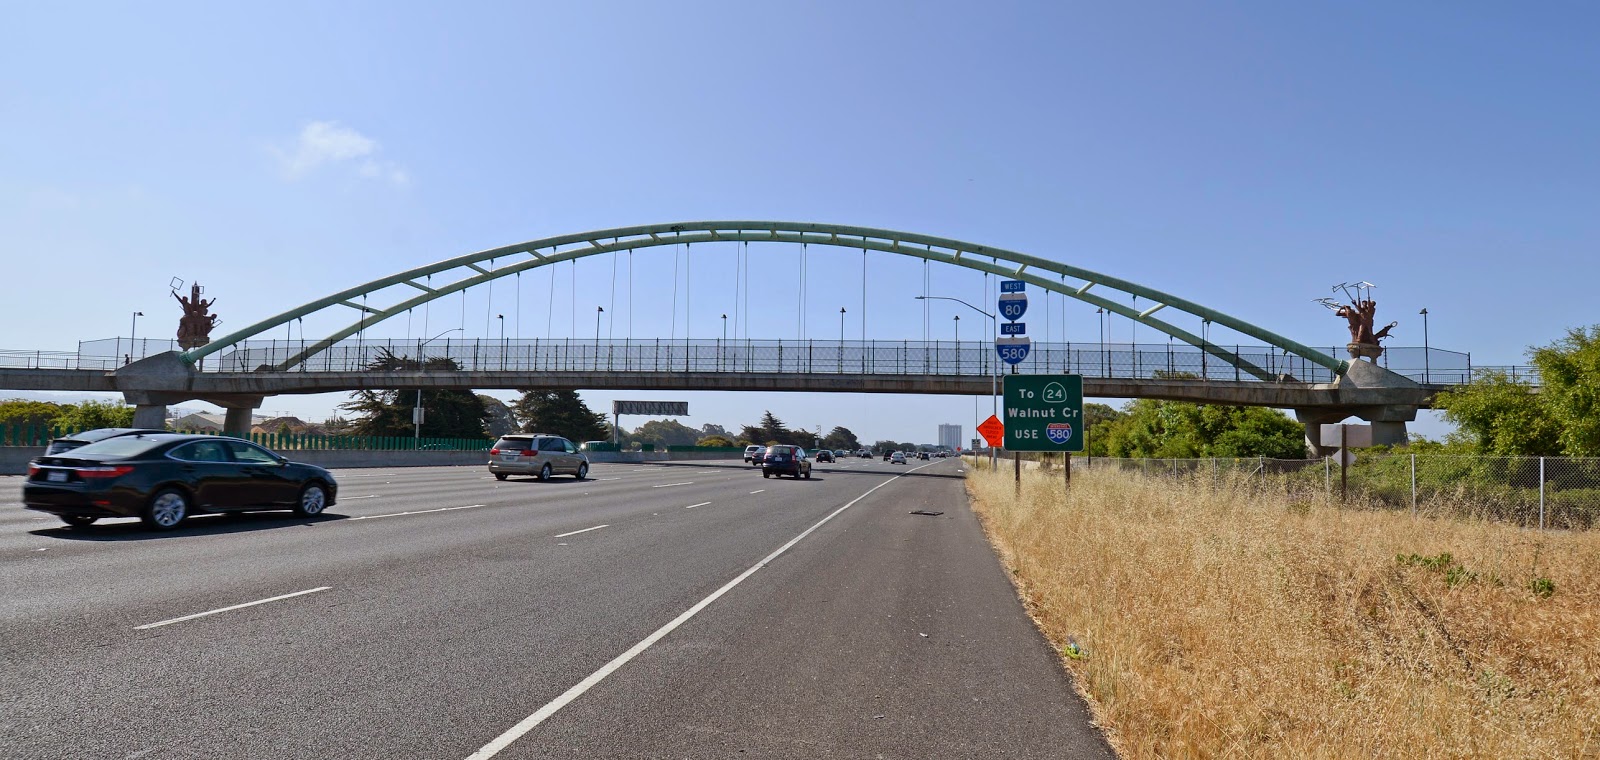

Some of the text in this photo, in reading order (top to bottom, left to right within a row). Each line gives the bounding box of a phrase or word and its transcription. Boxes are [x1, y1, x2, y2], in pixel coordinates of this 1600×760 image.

[1004, 282, 1021, 290] WEST
[1005, 304, 1021, 316] 80
[1005, 325, 1021, 333] EAST
[1002, 348, 1026, 359] 580
[1018, 388, 1063, 399] To 24
[1007, 406, 1079, 418] Walnut Cr
[1015, 428, 1070, 439] USE 580
